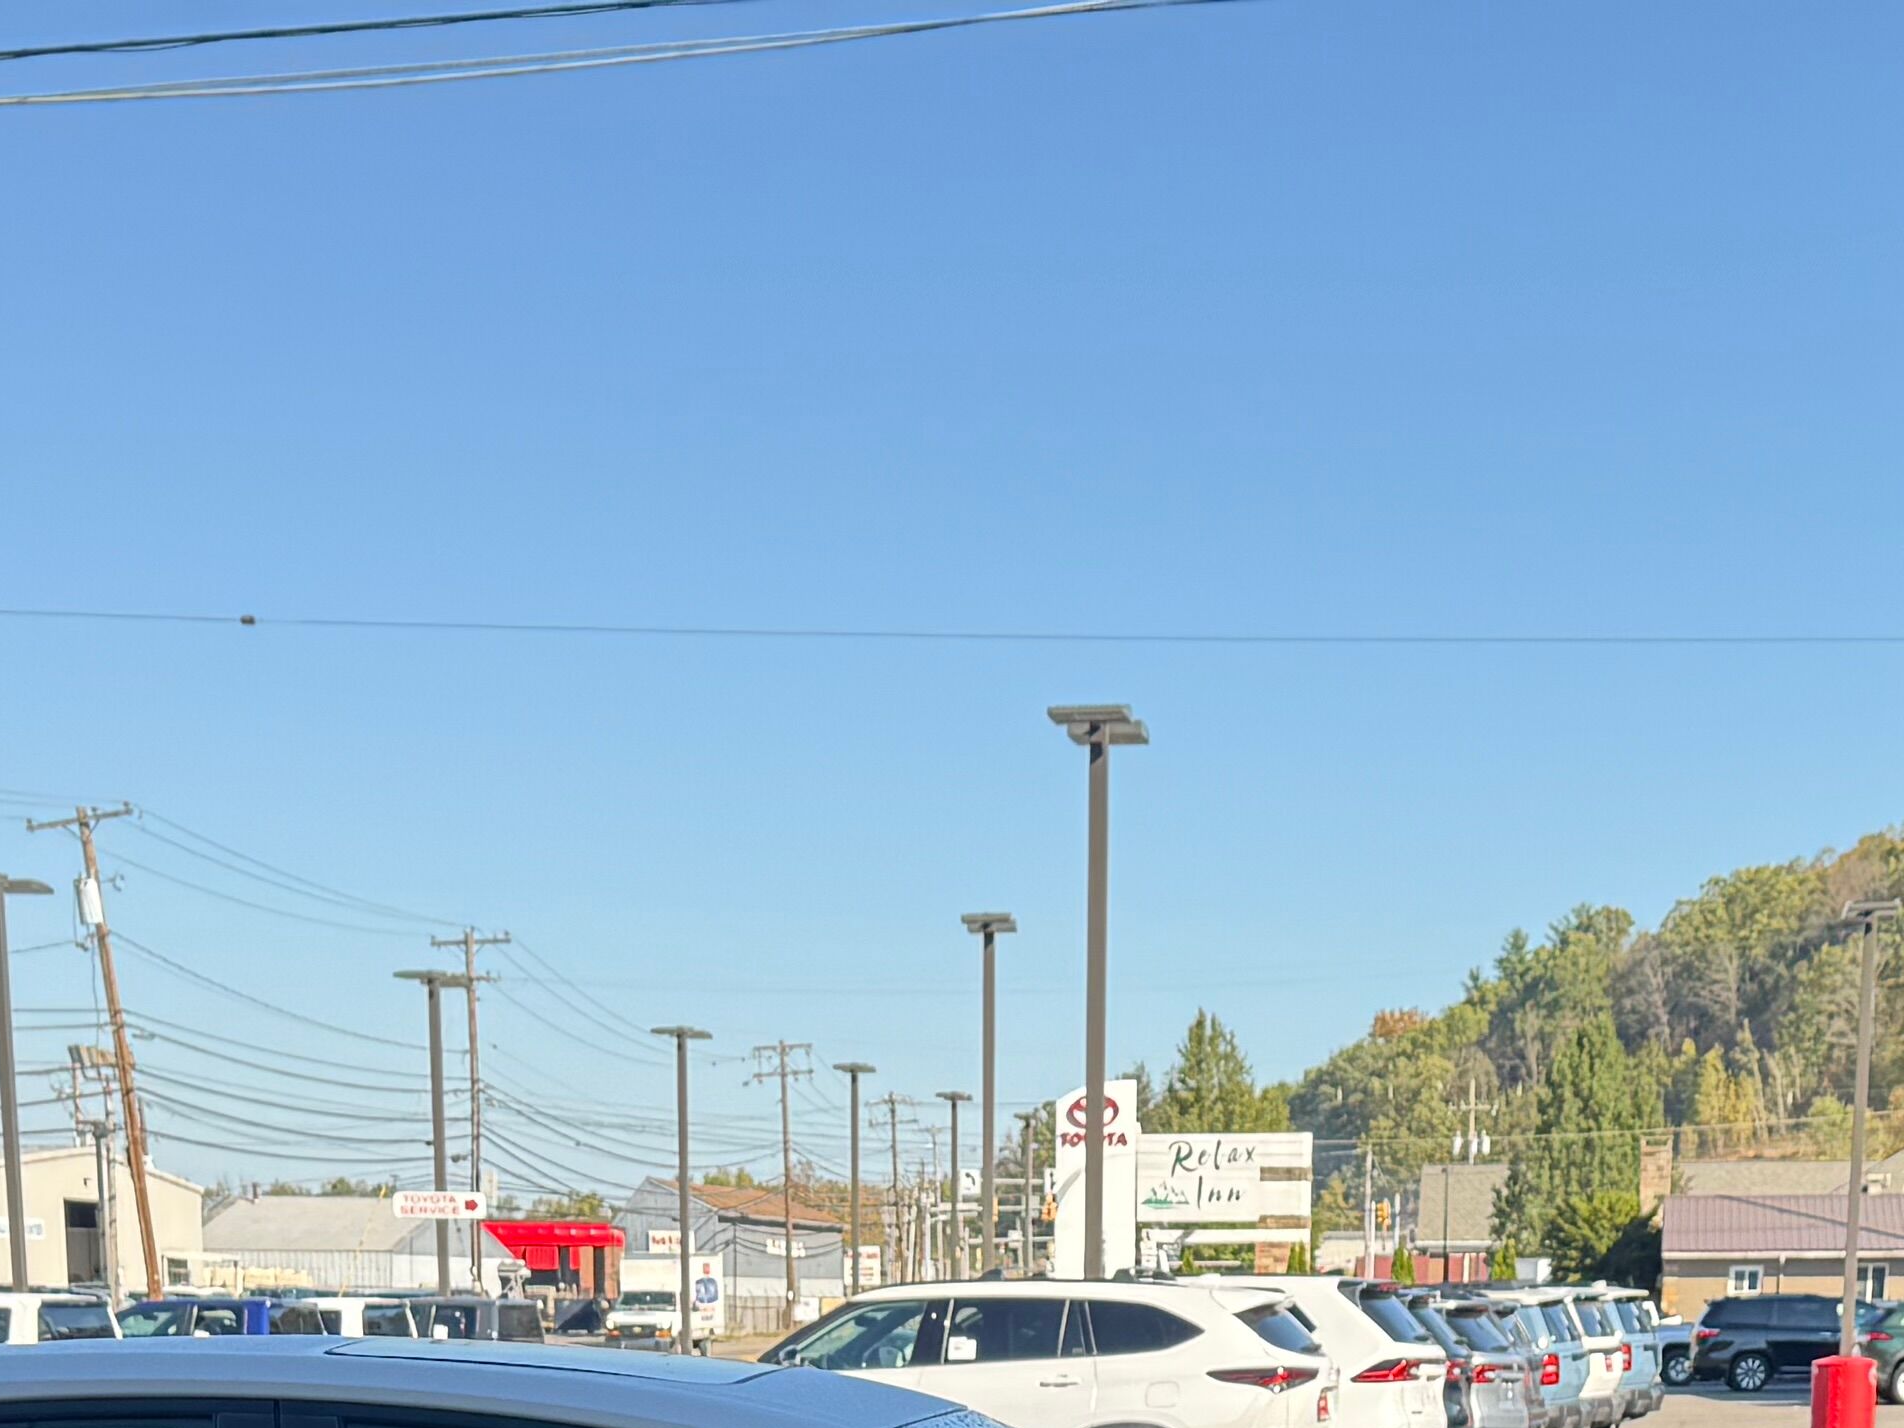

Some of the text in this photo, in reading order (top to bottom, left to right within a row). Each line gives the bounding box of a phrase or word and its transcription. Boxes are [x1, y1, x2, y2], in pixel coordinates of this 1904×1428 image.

[1059, 1131, 1128, 1148] TOTA
[1168, 1139, 1256, 1178] Relax
[403, 1194, 457, 1204] TOYOTA
[1197, 1175, 1244, 1209] Inn
[400, 1205, 460, 1215] SERVICE
